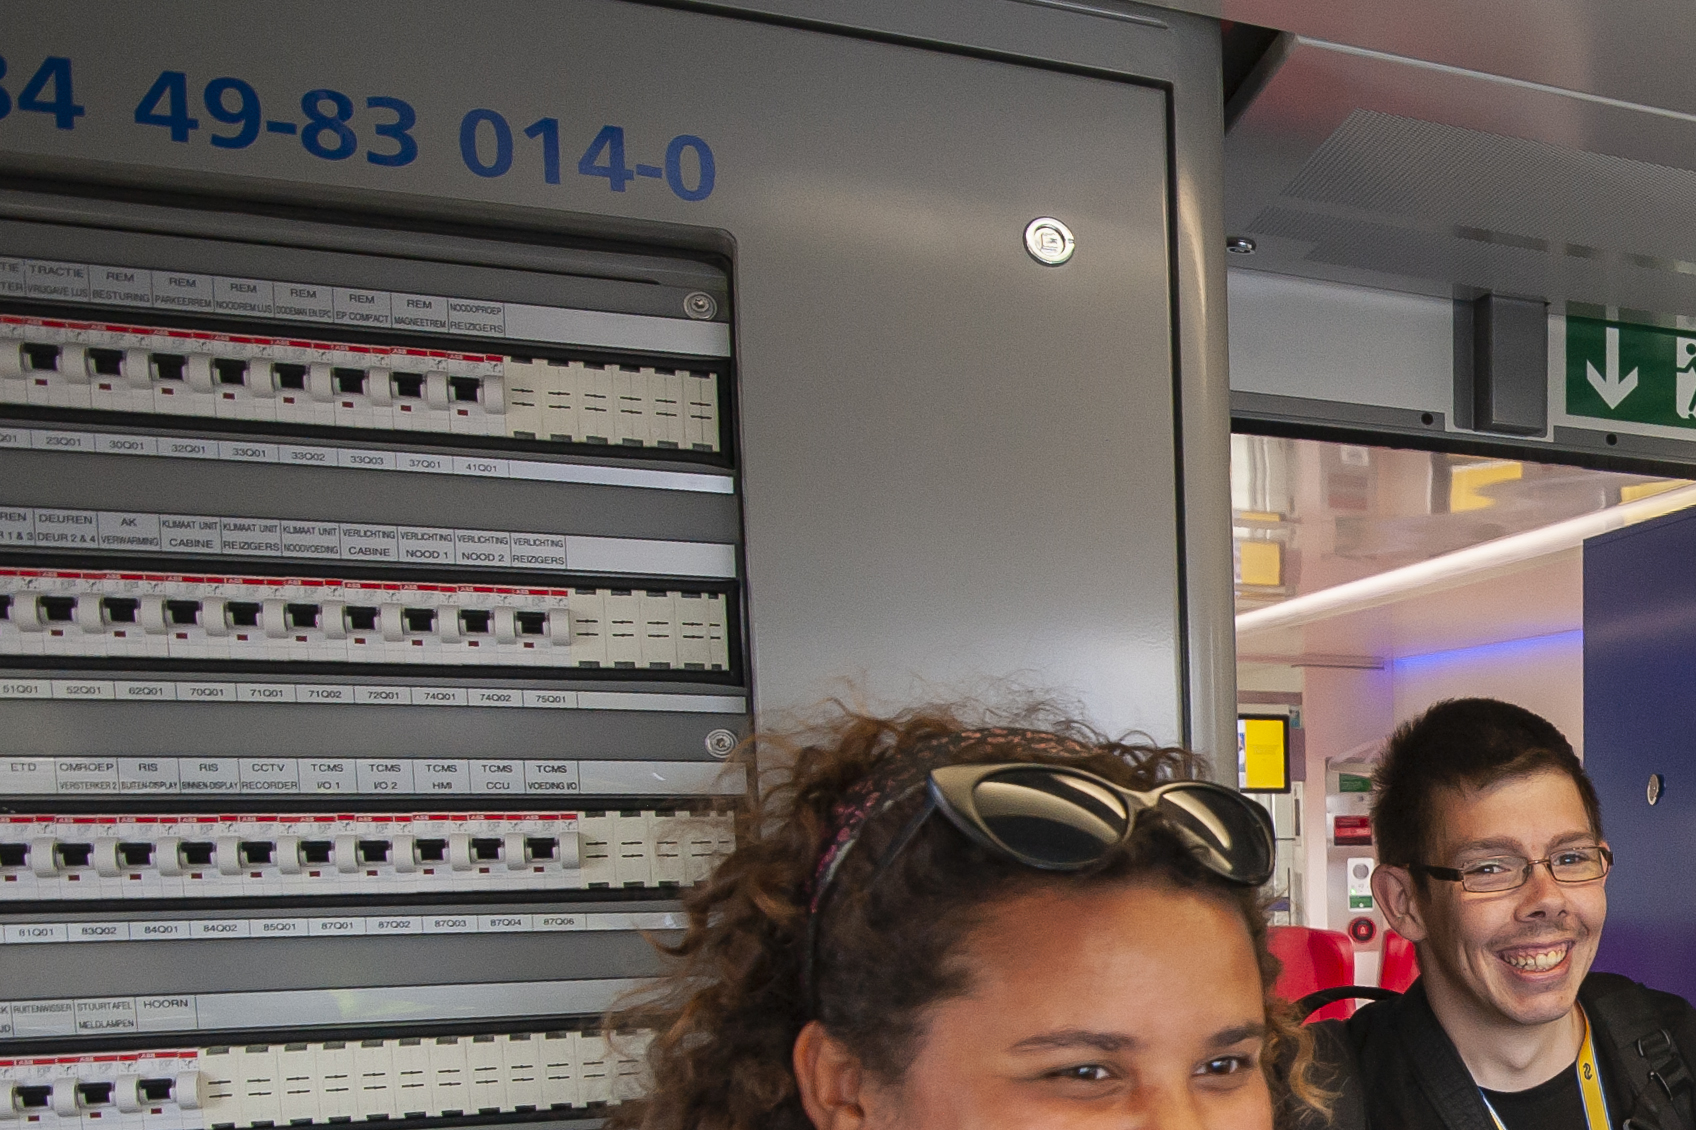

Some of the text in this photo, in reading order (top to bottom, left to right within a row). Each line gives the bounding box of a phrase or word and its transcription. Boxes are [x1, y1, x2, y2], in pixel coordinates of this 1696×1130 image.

[0, 55, 717, 202] 4 49-83 014-0
[29, 265, 84, 278] TRACTIE
[107, 271, 135, 282] REM
[170, 277, 197, 288] REM
[231, 283, 258, 293] REM
[92, 290, 151, 303] BESTURING
[290, 288, 318, 299] REM
[155, 296, 213, 308] PARKEERREM
[349, 294, 376, 305] REM
[407, 299, 433, 309] REM
[450, 303, 503, 315] NOODOPROEP
[349, 312, 389, 324] COMPACT
[394, 316, 447, 329] MAGNEETREM
[450, 322, 504, 334] REIZIGERS
[46, 436, 82, 446] 23Q01
[110, 440, 145, 451] 30Q01
[171, 444, 206, 454] 32Q01
[233, 448, 267, 458] 33Q01
[291, 451, 326, 461] 33Q02
[350, 455, 385, 465] 33Q03
[409, 459, 442, 469] 37Q01
[466, 463, 498, 473] 41Q01
[38, 513, 93, 525] DEUREN
[121, 517, 138, 528] AK
[162, 519, 218, 531] KLIMAAT UNIT
[223, 522, 278, 534] KLIMAAT UNIT
[37, 531, 69, 542] DEUR
[282, 526, 338, 537] KLIMAAT UNIT
[342, 528, 396, 540] VERLICHTING
[101, 535, 158, 547] VERWARMING
[400, 531, 453, 543] VERLICHTING
[456, 534, 509, 546] VERLICHTING
[169, 538, 214, 549] CABINE
[223, 541, 279, 552] REIZIGERS
[512, 537, 564, 549] VERLICHTING
[348, 546, 391, 557] CABINE
[406, 548, 440, 559] NOOD
[462, 552, 505, 562] NOOD 2
[512, 554, 565, 565] REIZIGERS
[3, 685, 39, 695] 51Q01
[66, 685, 101, 695] 52Q01
[128, 686, 163, 696] 62Q01
[189, 687, 224, 697] 70Q01
[249, 688, 284, 697] 71Q01
[308, 690, 342, 699] 71Q02
[368, 691, 399, 700] 72Q01
[424, 692, 456, 701] 74Q01
[480, 693, 512, 702] 74Q02
[536, 694, 567, 704] 75Q01
[10, 763, 37, 772] ETD
[59, 762, 114, 772] OMROEP
[138, 763, 158, 772] RIS
[199, 763, 219, 772] RIS
[251, 763, 286, 773] CCTV
[311, 763, 344, 773] TCMS
[368, 763, 401, 773] TCMS
[425, 764, 458, 773] TCMS
[481, 764, 513, 773] TCMS
[536, 764, 568, 774] TCMS
[60, 781, 109, 791] VERSTERKER
[241, 780, 298, 791] RECORDER
[390, 781, 398, 790] 2
[432, 781, 453, 790] HMI
[485, 781, 510, 791] CCU
[527, 781, 564, 791] VOEDING
[263, 922, 297, 932] 85Q01
[321, 921, 354, 930] 87Q01
[378, 920, 411, 930] 87Q02
[434, 919, 467, 928] 87Q03
[490, 918, 522, 927] 87Q04
[81, 926, 117, 936] 83Q02
[144, 925, 179, 935] 84Q01
[203, 924, 238, 933] 84Q02
[13, 1003, 72, 1013] RUITENWISSER
[77, 1001, 132, 1012] STUURTAFEL
[143, 999, 189, 1009] HOORN
[79, 1018, 135, 1029] MELDLAMPEN
